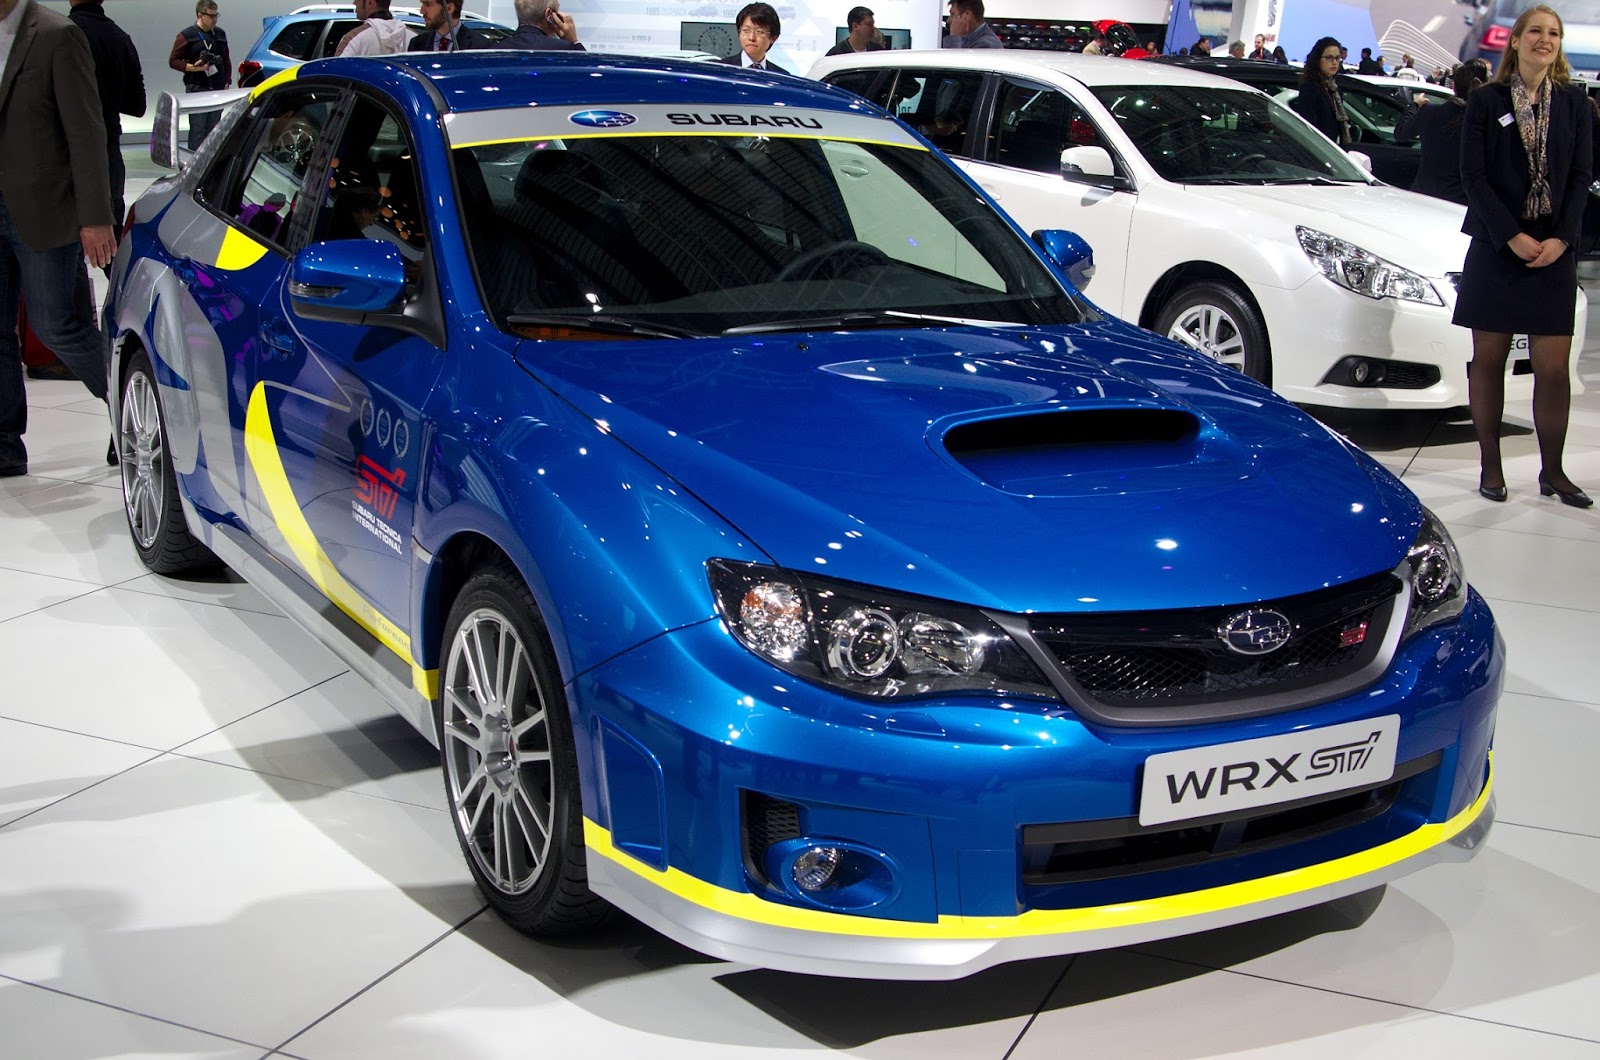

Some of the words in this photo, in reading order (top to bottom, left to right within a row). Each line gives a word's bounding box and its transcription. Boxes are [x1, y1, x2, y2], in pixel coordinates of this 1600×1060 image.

[646, 7, 660, 16] 1995
[723, 9, 737, 18] 1997
[666, 113, 823, 129] SUBARU
[352, 500, 376, 523] SUBARU
[376, 517, 402, 544] TECNICA
[352, 510, 402, 555] INTERNATIONAL
[1166, 752, 1302, 804] WRX
